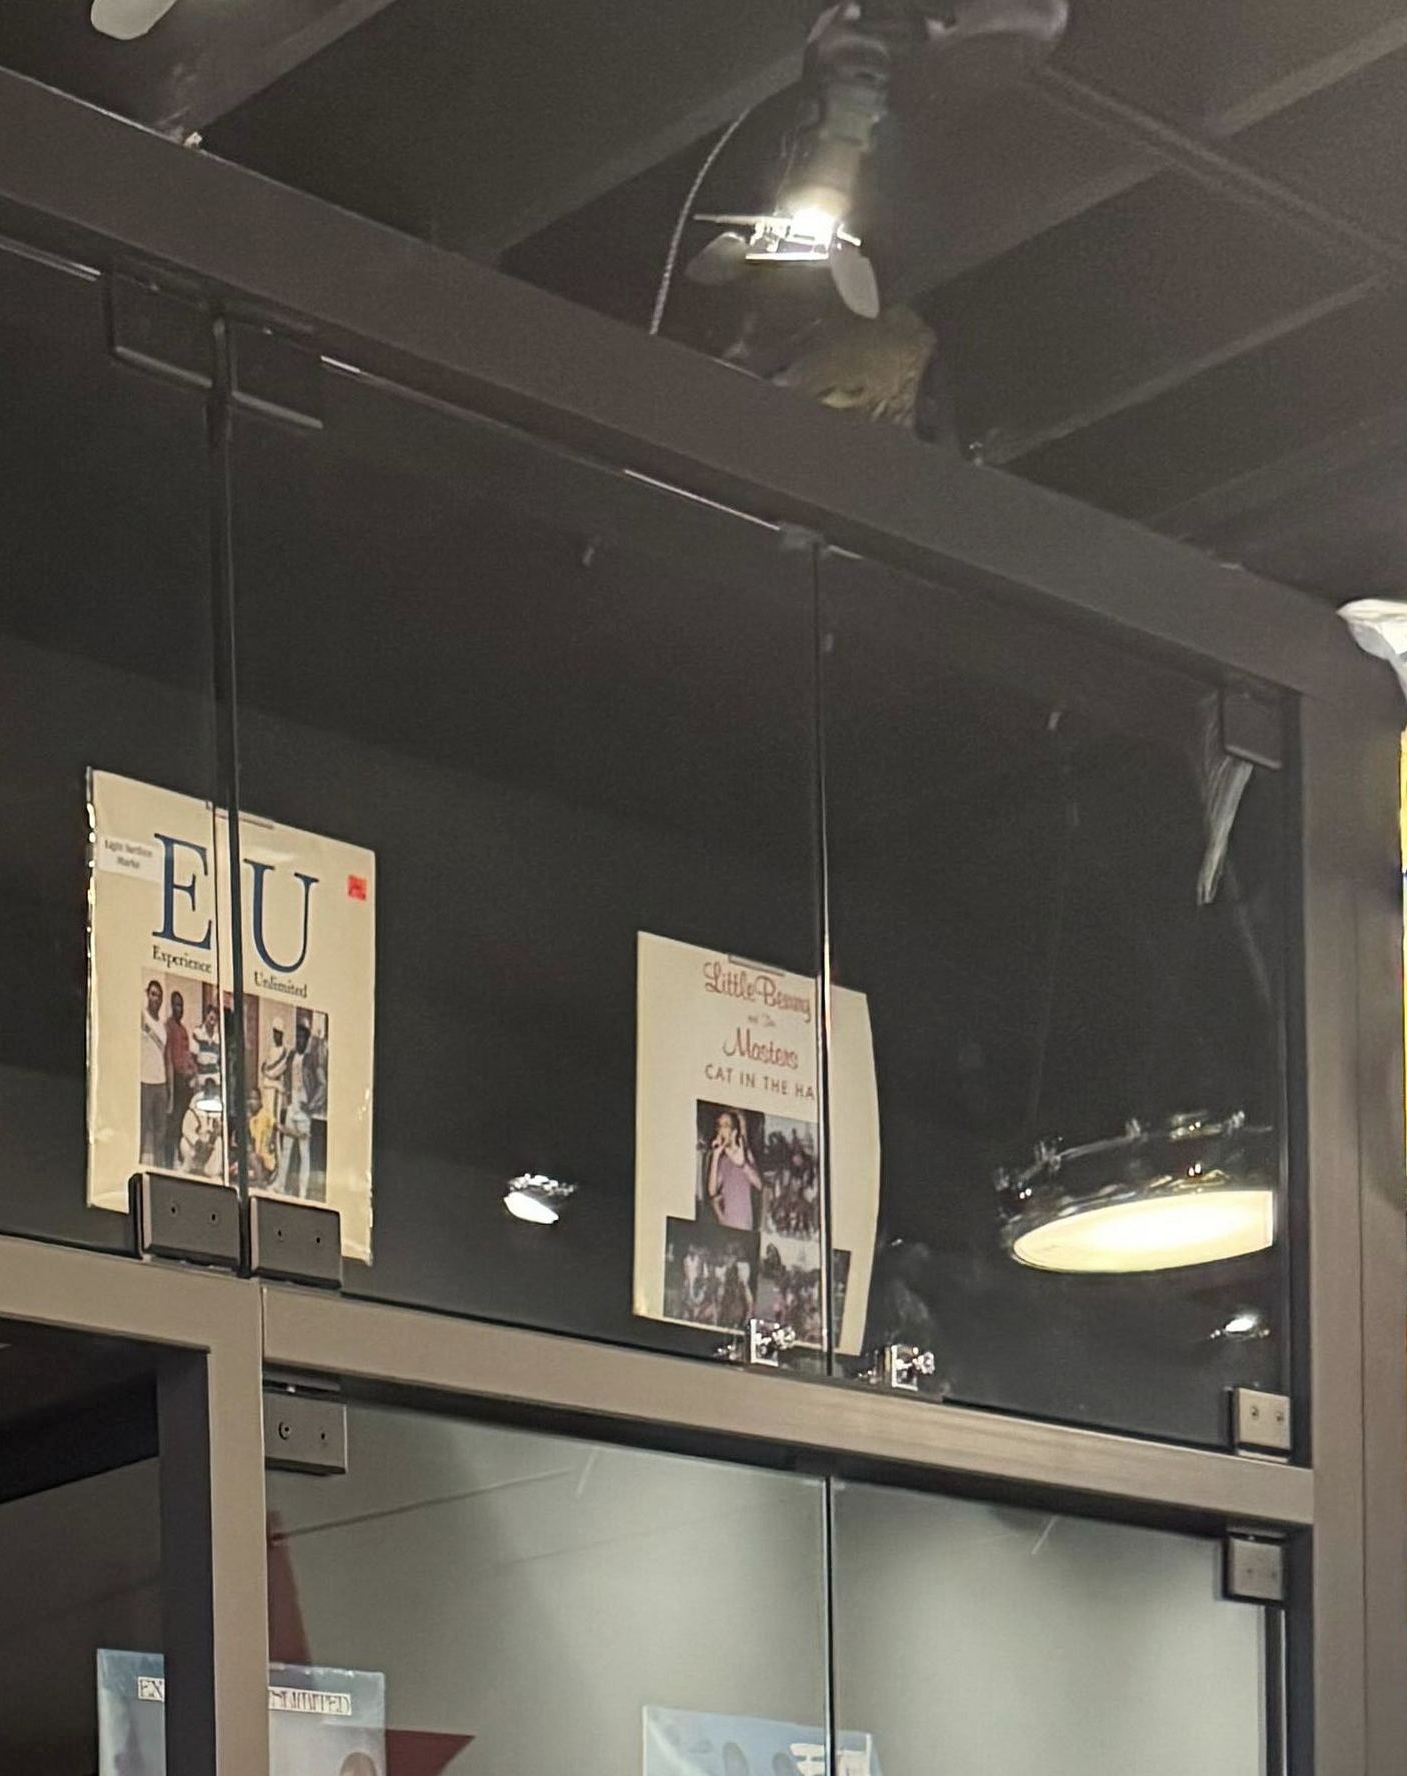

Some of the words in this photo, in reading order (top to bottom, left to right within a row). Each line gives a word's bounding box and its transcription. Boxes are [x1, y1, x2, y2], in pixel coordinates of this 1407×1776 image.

[151, 944, 212, 975] Experience
[253, 970, 308, 999] Unlimited
[703, 961, 755, 1002] Little
[722, 1027, 799, 1070] Masters
[704, 1063, 734, 1084] CAT
[739, 1072, 756, 1088] IN
[763, 1076, 788, 1095] THE
